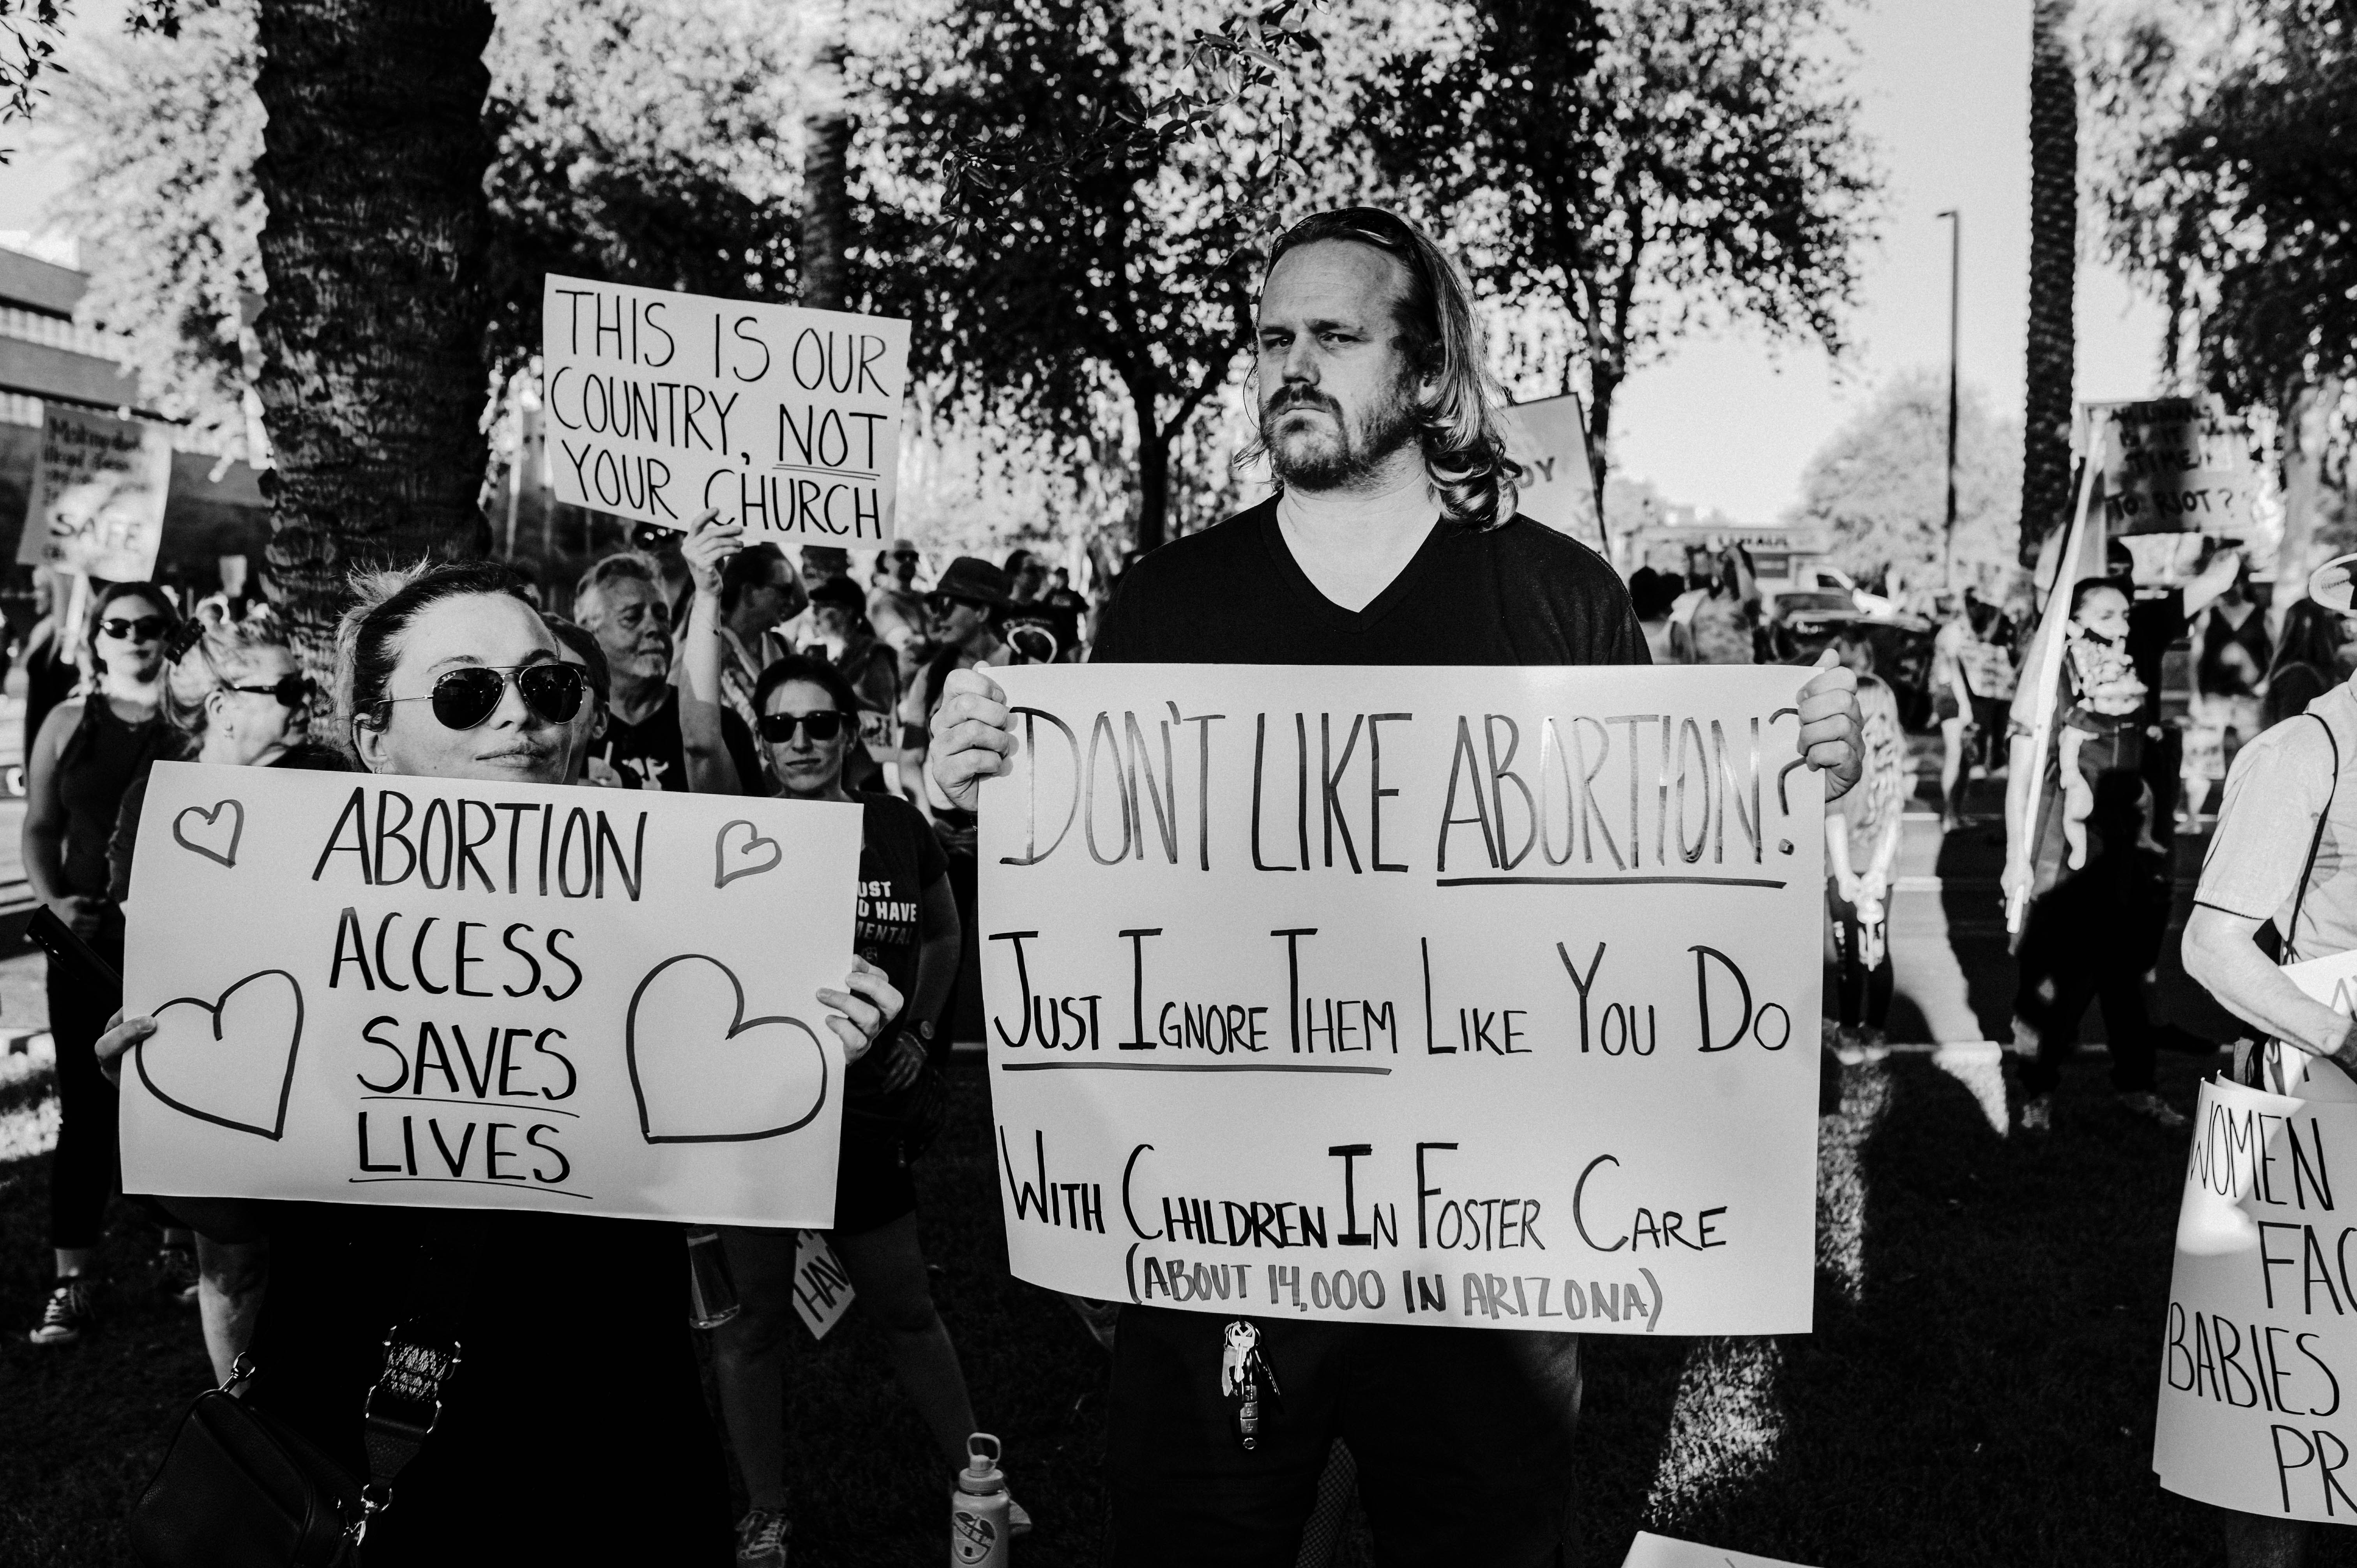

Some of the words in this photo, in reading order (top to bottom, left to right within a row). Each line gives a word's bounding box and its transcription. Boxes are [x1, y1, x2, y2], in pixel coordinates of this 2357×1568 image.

[555, 290, 674, 367] THIS
[716, 314, 769, 382] IS
[793, 328, 889, 397] OUR
[551, 366, 750, 465] COUNTRY,
[779, 404, 887, 468] NOT
[562, 440, 678, 520] YOUR
[704, 469, 881, 539] CHURCH
[1000, 701, 1226, 871] DON'T
[1251, 712, 1412, 874] LIKE
[1437, 708, 1808, 872] ABORTION?
[312, 787, 648, 901] ABORTION
[329, 907, 582, 1001] ACCESS
[875, 901, 916, 922] HAVE
[357, 1015, 577, 1100] SAVES
[359, 1111, 570, 1183] LIVES
[2190, 1101, 2334, 1211] WOMEN
[1125, 1242, 1252, 1304] (ABOUT
[1403, 1270, 1445, 1314] IN
[1463, 1268, 1663, 1332] ARIZONA)
[2168, 1302, 2339, 1416] BABIES
[2270, 1424, 2357, 1516] PR
